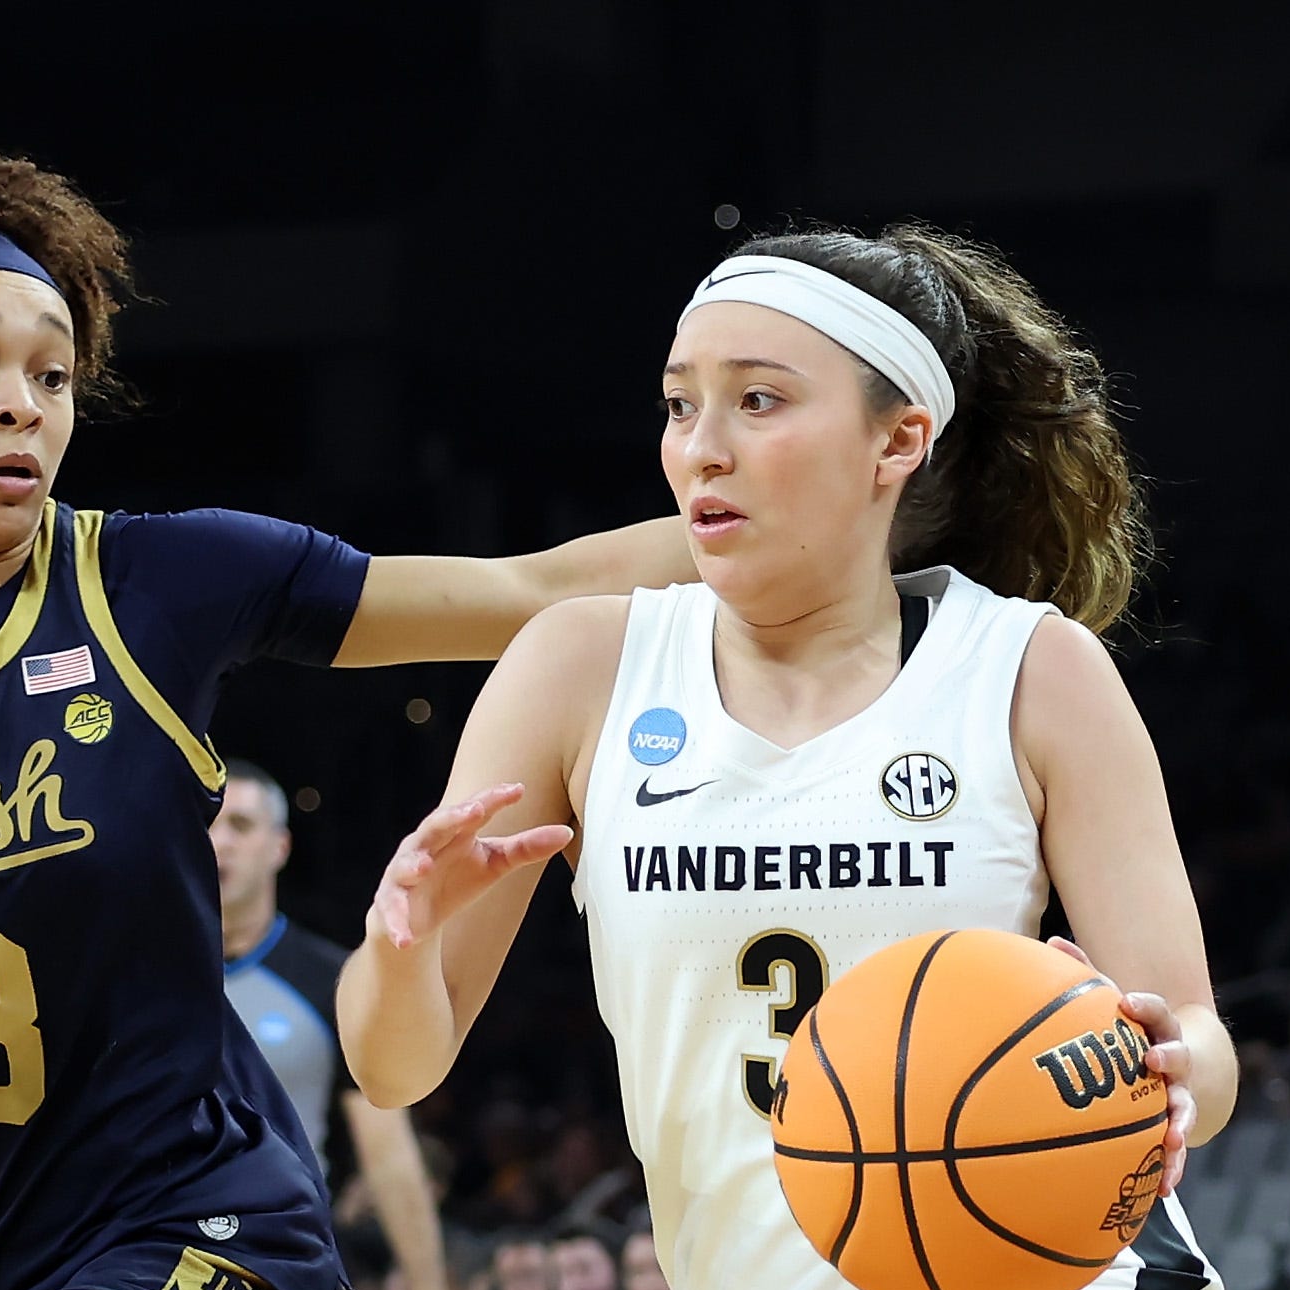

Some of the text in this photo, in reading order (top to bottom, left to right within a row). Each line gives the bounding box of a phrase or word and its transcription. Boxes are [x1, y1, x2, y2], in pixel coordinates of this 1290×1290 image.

[71, 703, 110, 726] ACC
[632, 732, 680, 752] NCAA
[883, 754, 955, 816] SEC
[623, 841, 954, 892] VANDERBILT
[736, 927, 830, 1121] 3
